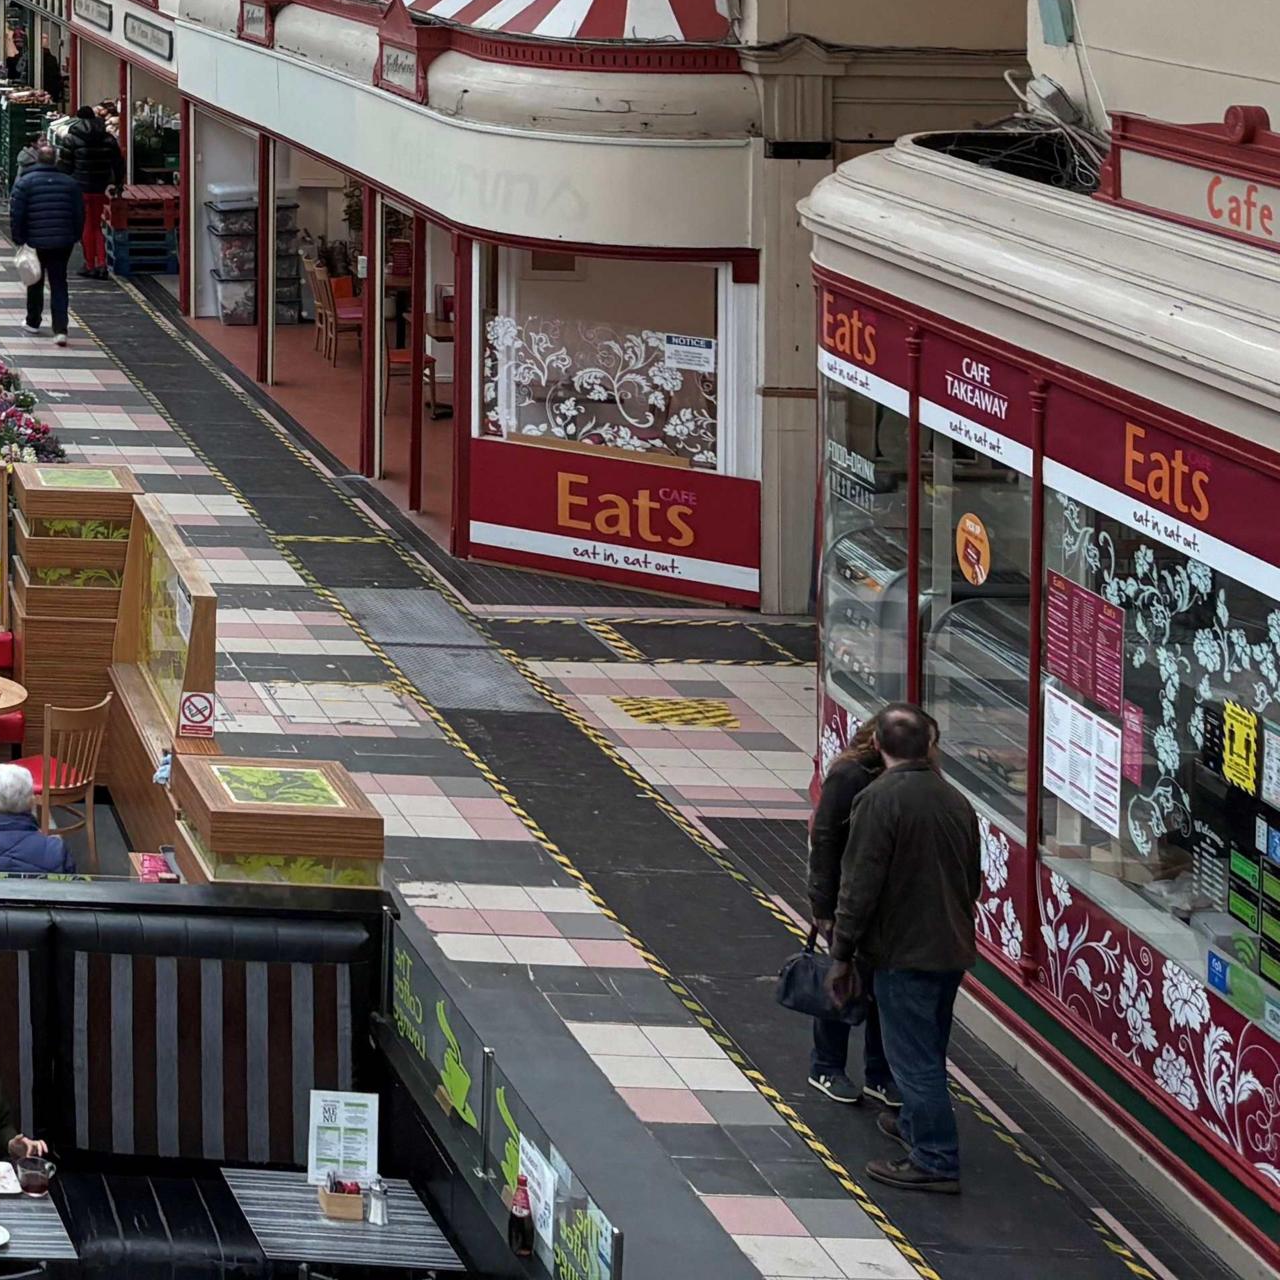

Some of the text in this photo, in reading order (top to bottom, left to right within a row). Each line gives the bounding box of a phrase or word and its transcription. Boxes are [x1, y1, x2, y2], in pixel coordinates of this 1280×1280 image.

[1207, 175, 1273, 236] Cafe
[672, 336, 707, 348] NOTICE
[822, 291, 877, 366] Eats
[962, 357, 991, 387] CAFE
[945, 374, 1009, 420] TAKEAWAY
[949, 420, 963, 435] eat
[974, 431, 988, 447] eat
[1124, 421, 1210, 521] Eats
[557, 471, 695, 547] Eats
[659, 487, 697, 506] CAFE
[1133, 510, 1200, 553] eat in, eat out.
[573, 545, 682, 575] eat in, eat out.
[322, 1114, 337, 1123] NU
